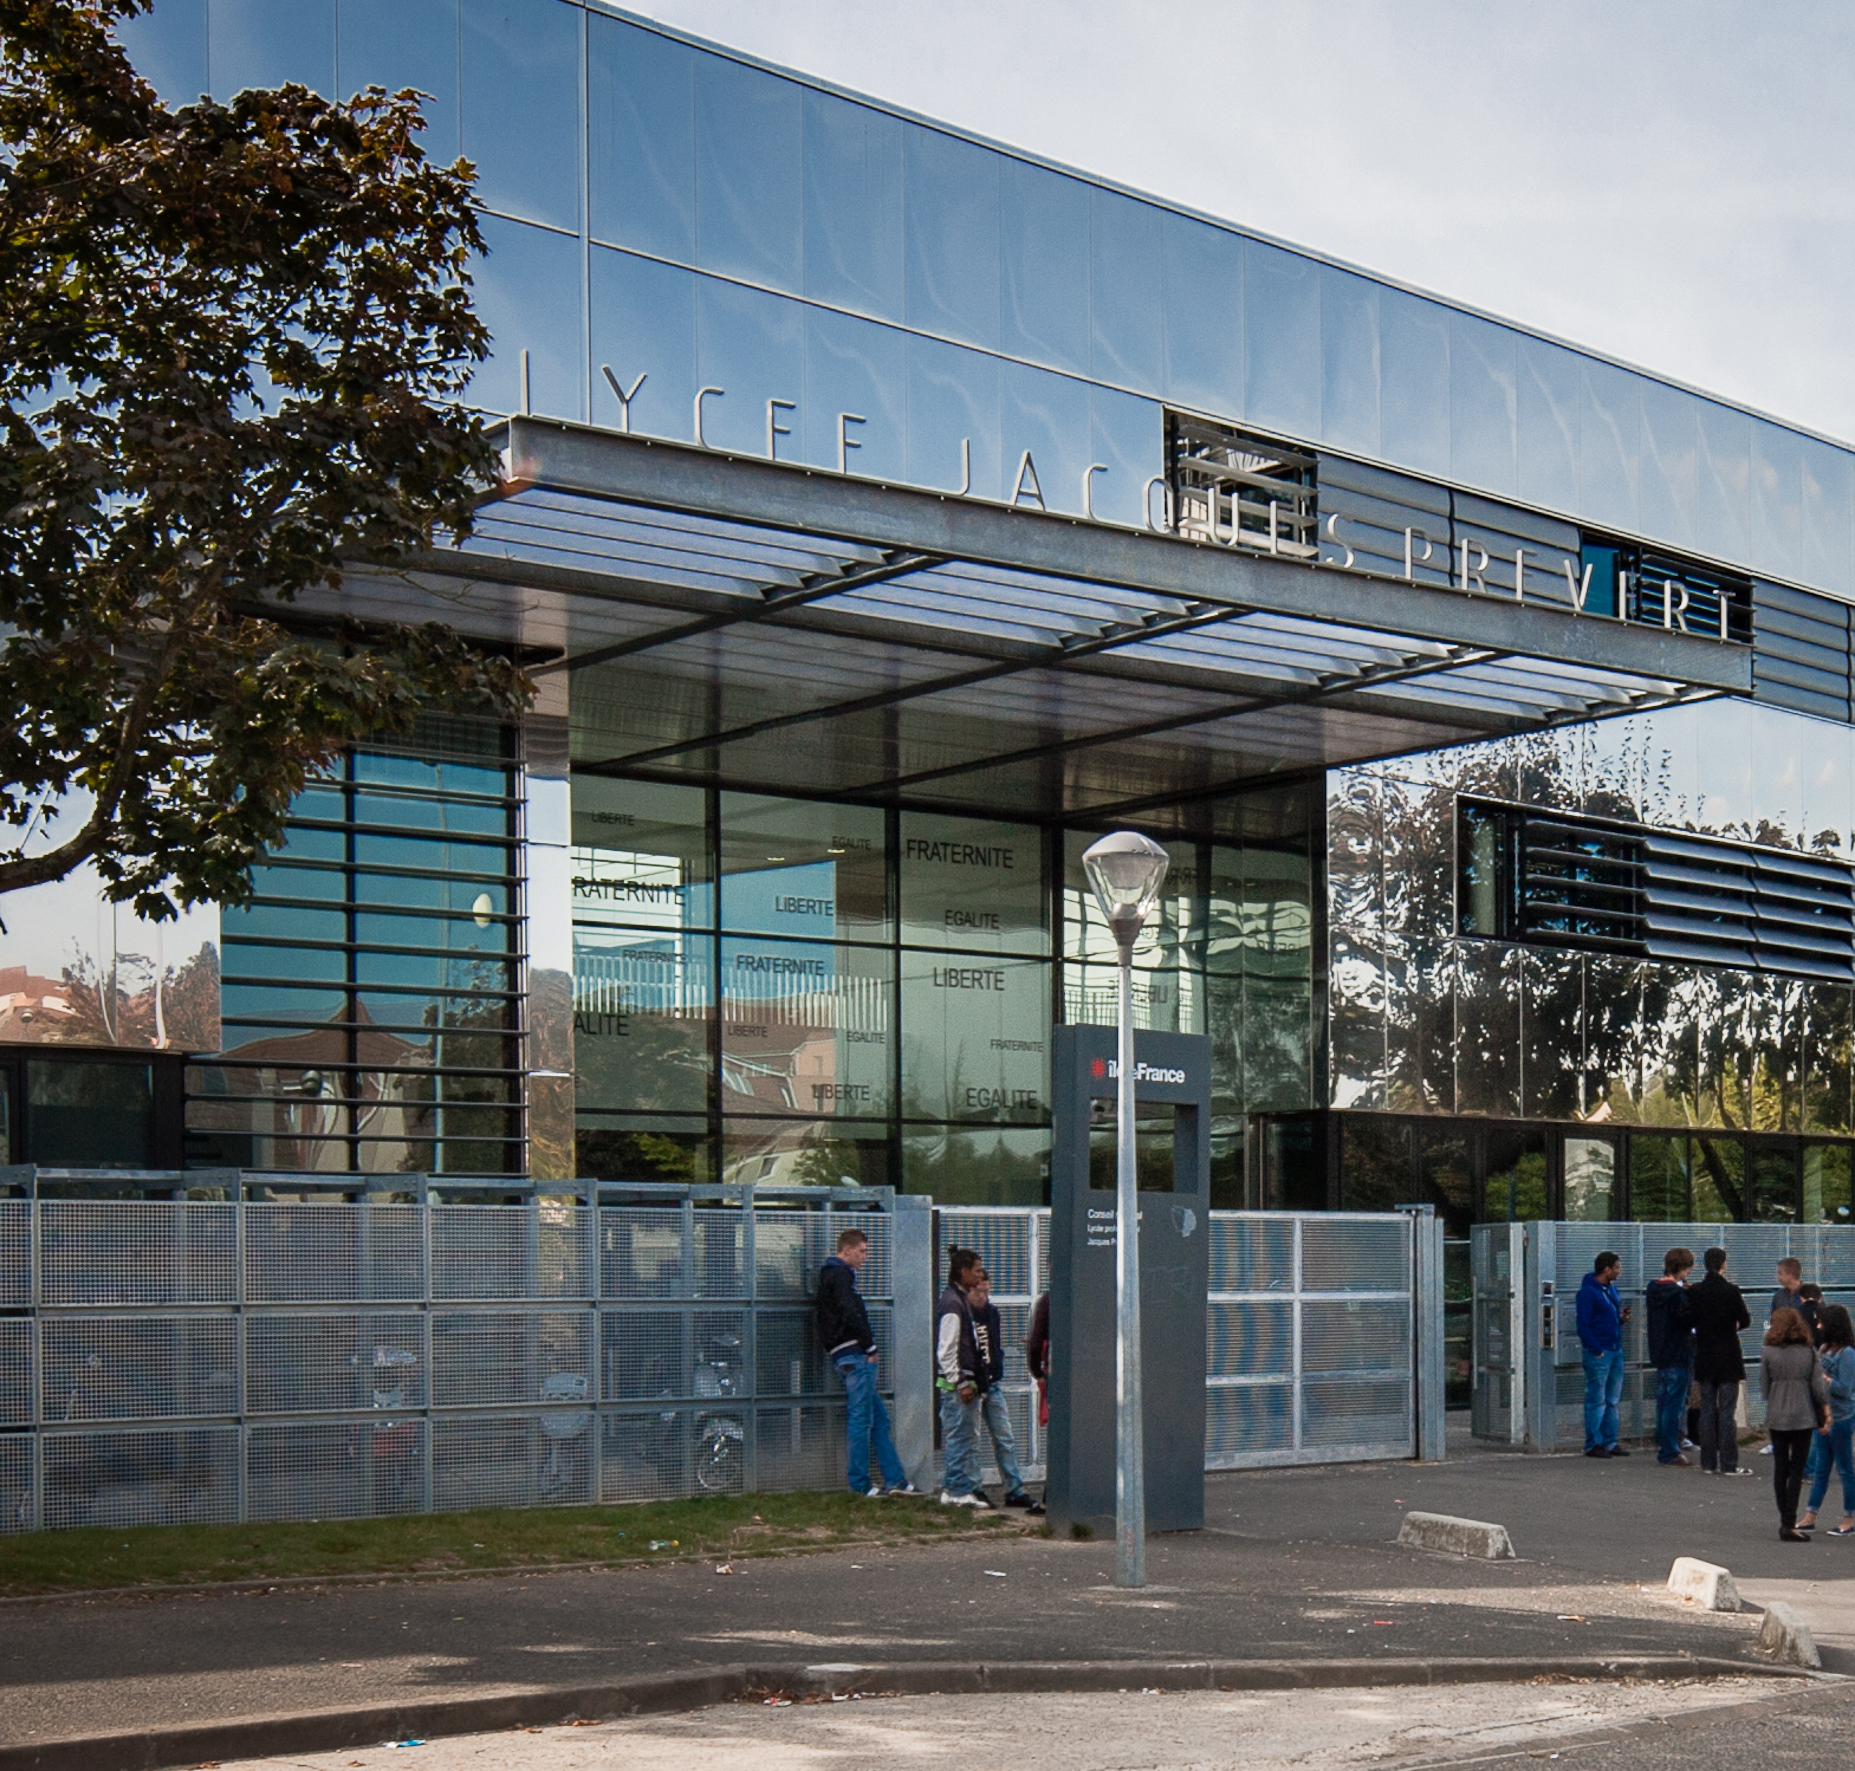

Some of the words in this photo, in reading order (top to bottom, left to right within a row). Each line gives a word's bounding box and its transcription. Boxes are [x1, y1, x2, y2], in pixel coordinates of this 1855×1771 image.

[591, 812, 635, 826] LIBERTE
[832, 836, 871, 851] EGALITE
[906, 839, 1014, 869] FRATERNITE
[573, 876, 686, 906] RATERNITE
[775, 896, 834, 916] LIBERTE
[945, 910, 1000, 930] EGALITE
[736, 954, 825, 976] FRATERNITE
[933, 967, 1005, 991] LIBERTE
[574, 1013, 629, 1036] ALITE
[728, 1025, 768, 1038] LIBERTE
[846, 1031, 885, 1044] EGALITE
[990, 1039, 1044, 1052] FRATERNITE
[812, 1085, 870, 1101] LIBERTE
[966, 1088, 1037, 1110] EGALITE
